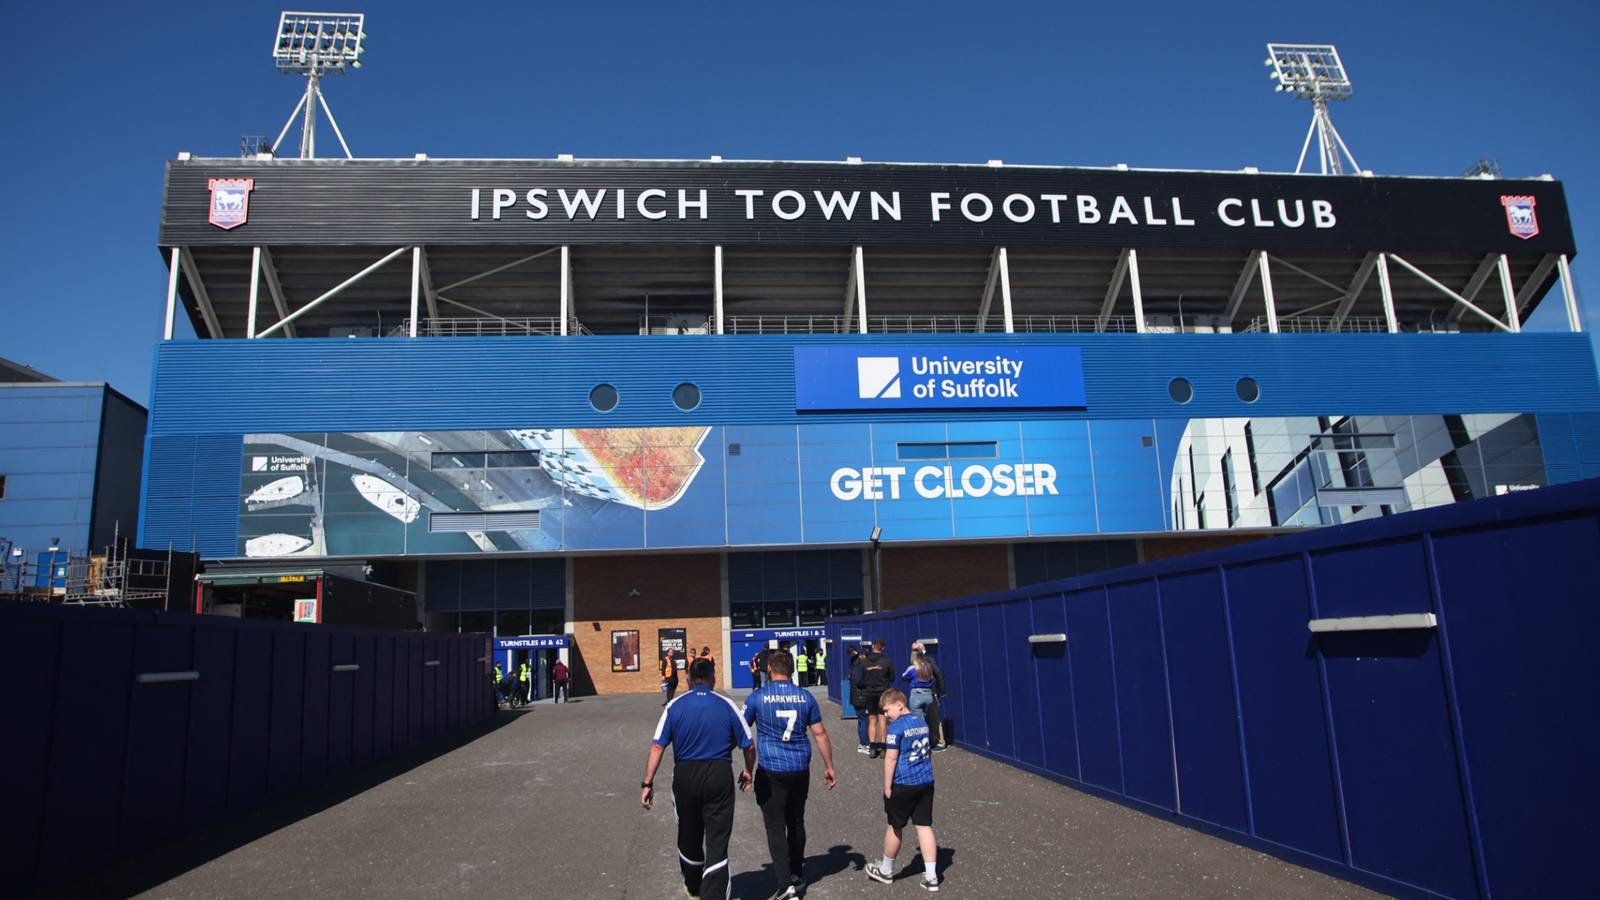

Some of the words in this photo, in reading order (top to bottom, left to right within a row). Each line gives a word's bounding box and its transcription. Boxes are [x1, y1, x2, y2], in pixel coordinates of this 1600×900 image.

[470, 188, 708, 221] IPSWICH
[735, 189, 902, 221] TOWN
[930, 192, 1196, 226] FOOTBALL
[1217, 197, 1337, 228] CLUB
[911, 356, 1023, 378] University
[913, 378, 936, 398] of
[941, 378, 1019, 398] Suffolk
[271, 456, 310, 464] University
[830, 466, 906, 501] GET
[914, 463, 1059, 499] CLOSER
[763, 694, 807, 704] MARKWELL
[775, 710, 798, 741] 7
